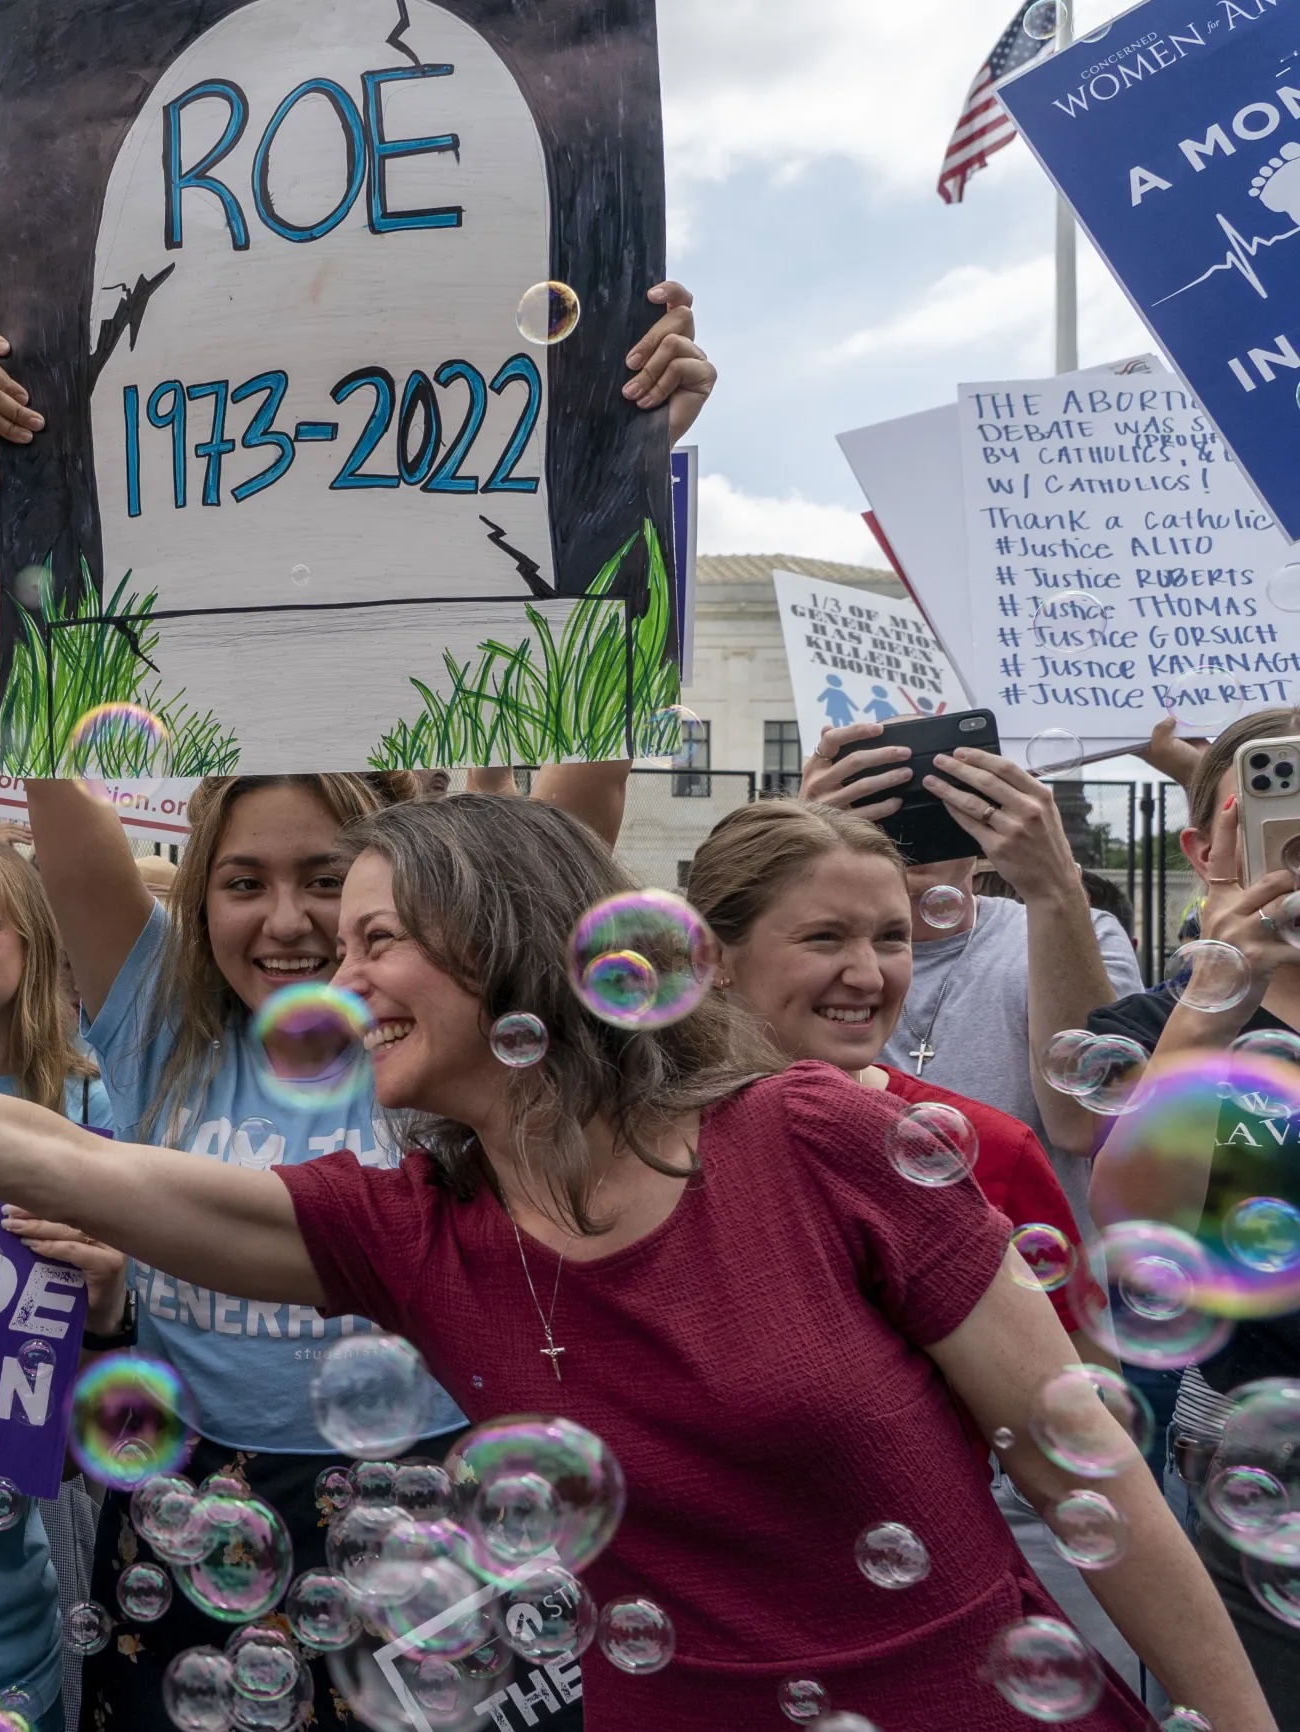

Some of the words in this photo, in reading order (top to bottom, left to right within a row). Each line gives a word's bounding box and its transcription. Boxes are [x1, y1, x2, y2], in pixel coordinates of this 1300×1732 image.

[1052, 23, 1206, 118] WOMEN
[1207, 19, 1221, 35] for
[1081, 31, 1158, 79] CONCERNED
[162, 63, 466, 251] ROE
[1129, 166, 1173, 207] A
[968, 392, 1042, 419] THE
[123, 353, 542, 517] 1973-2022
[977, 419, 1094, 443] DEBATE
[1114, 416, 1175, 436] WAS
[982, 446, 1020, 464] BY
[979, 506, 1090, 532] Thank
[1105, 513, 1125, 531] a
[995, 536, 1115, 559] #Justice
[1130, 536, 1213, 557] ALITO
[848, 604, 880, 622] OF
[889, 614, 927, 634] MY
[1128, 593, 1258, 618] THOMAS
[811, 622, 863, 646] HAS
[871, 636, 933, 664] BEEN
[1148, 623, 1278, 649] GORSUCH
[804, 634, 902, 670] KILLED
[911, 655, 944, 681] BY
[810, 650, 944, 695] ABORTION
[1151, 679, 1293, 708] BARRETT
